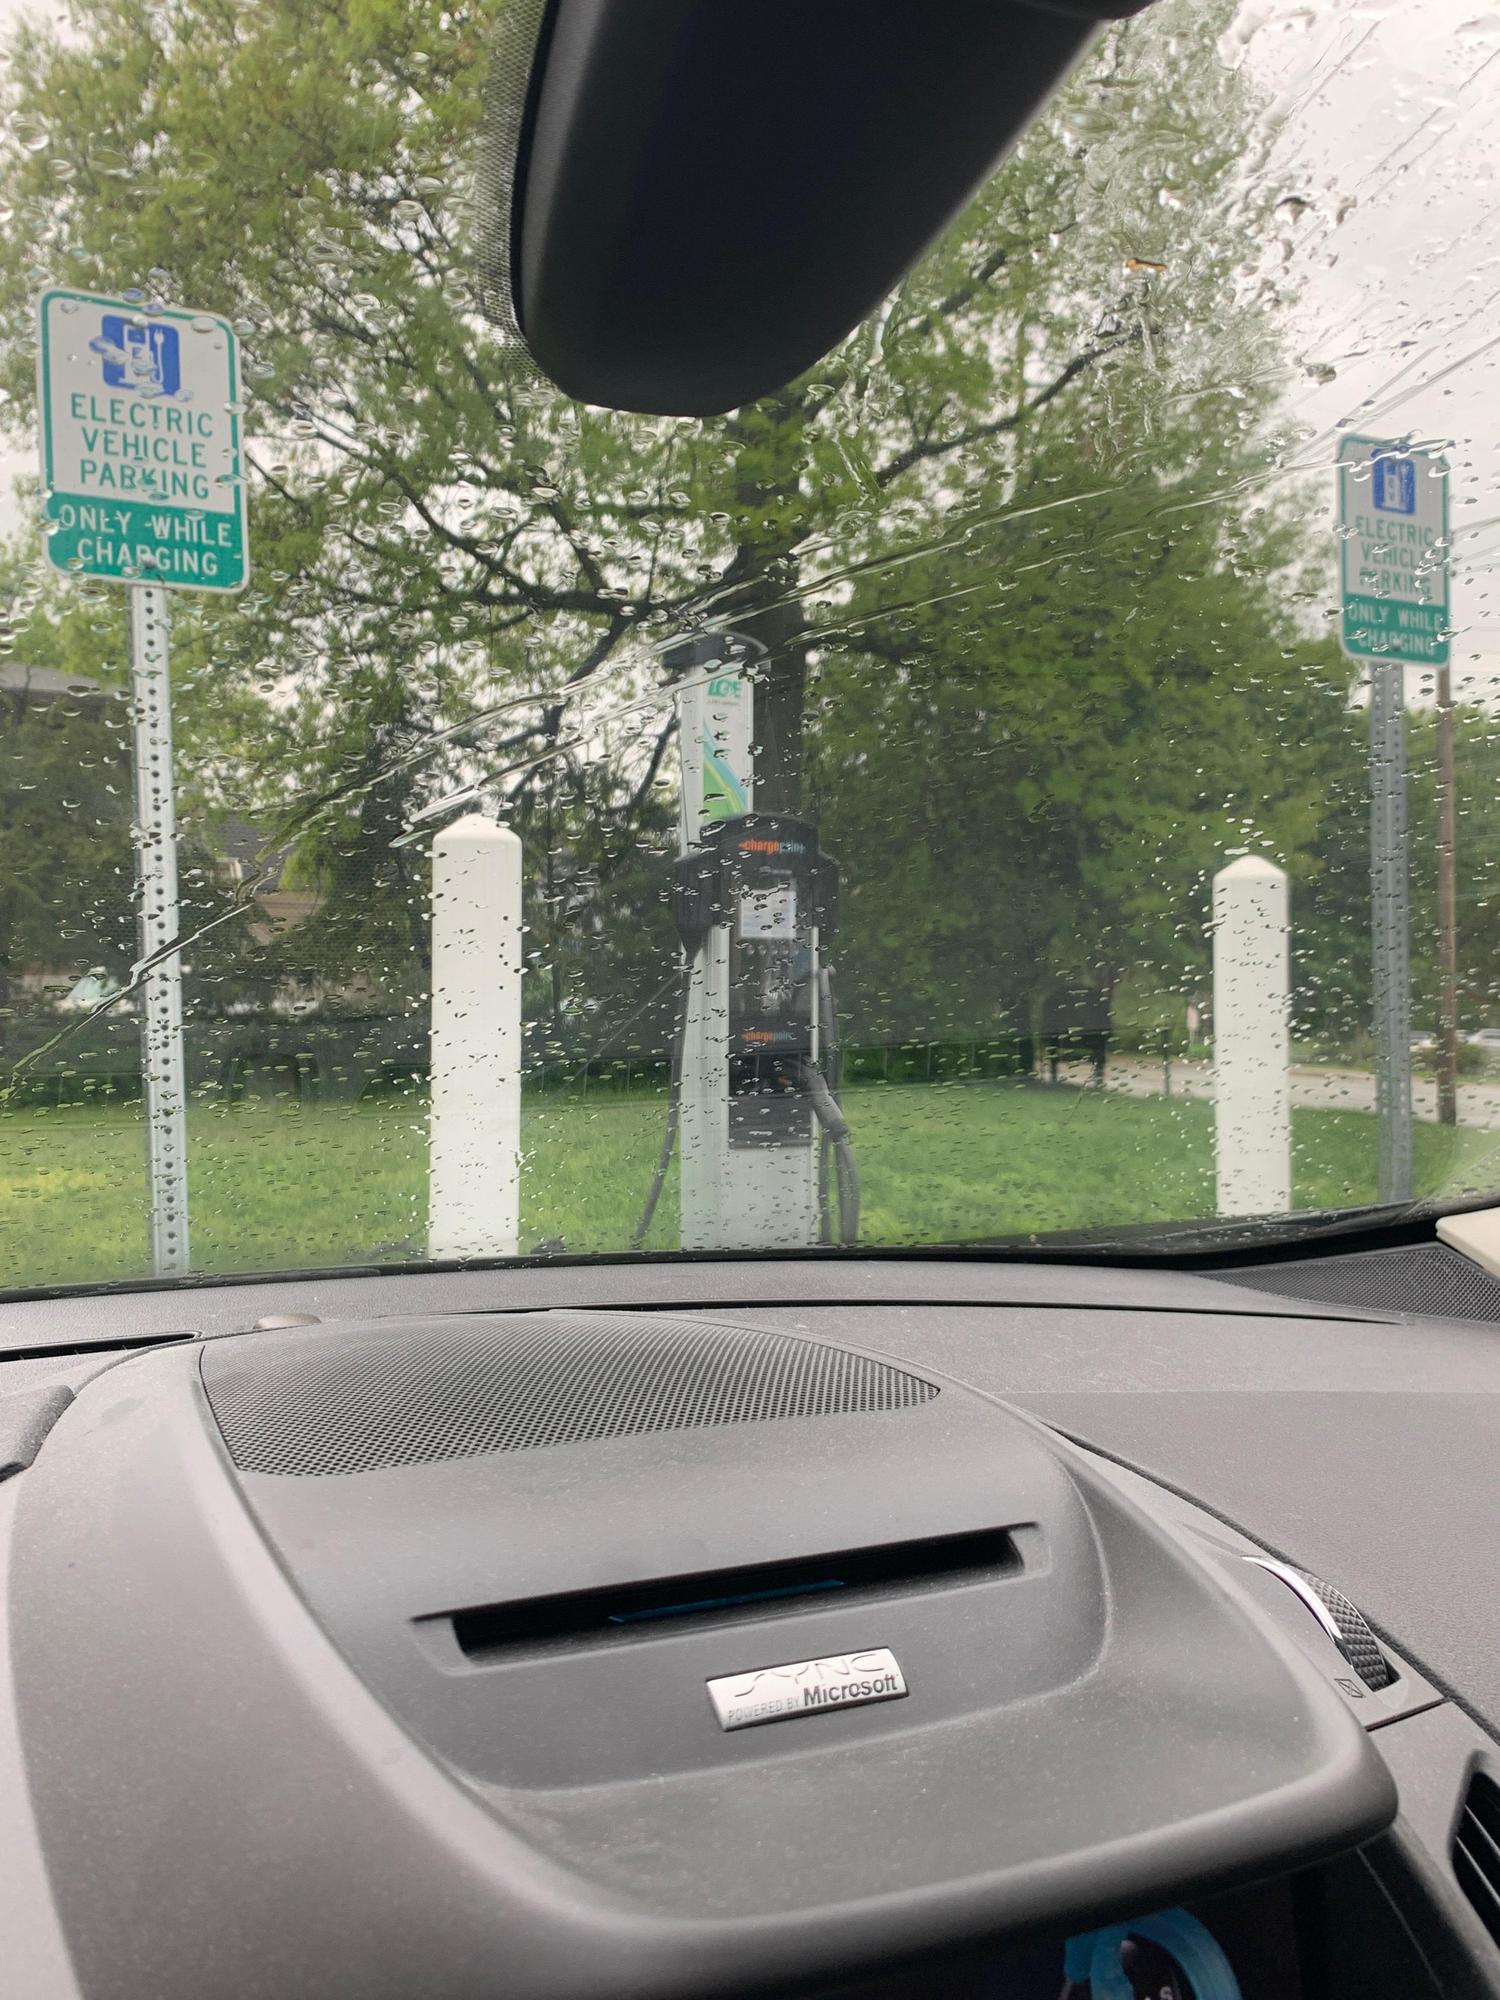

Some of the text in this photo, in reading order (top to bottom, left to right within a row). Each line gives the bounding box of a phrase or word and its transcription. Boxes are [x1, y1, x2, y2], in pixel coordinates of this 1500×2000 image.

[70, 392, 214, 438] ELECTRIC
[81, 426, 208, 469] VEHICLE
[79, 459, 210, 500] PARKING
[59, 503, 233, 547] ONLY WHILE
[1355, 515, 1434, 547] ELECTRIC
[76, 538, 219, 576] CHARGING
[1359, 567, 1432, 595] PARKING
[1350, 600, 1443, 633] ONLY WHILE
[727, 1673, 898, 1722] POWERED BY Microsoft
